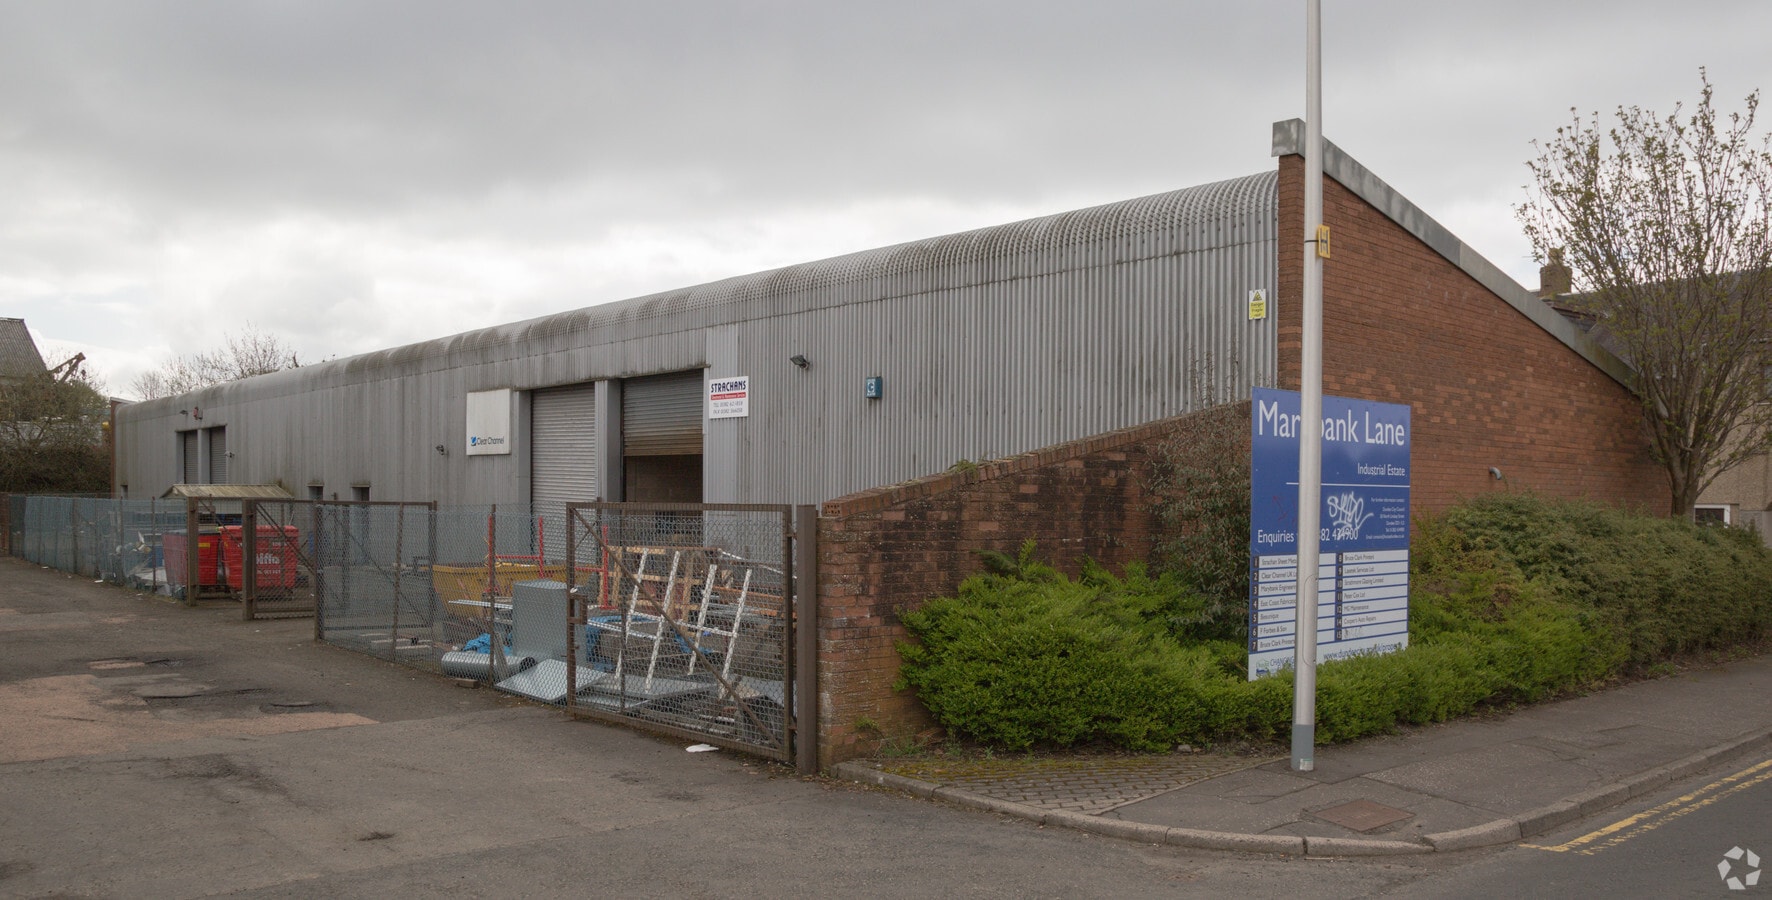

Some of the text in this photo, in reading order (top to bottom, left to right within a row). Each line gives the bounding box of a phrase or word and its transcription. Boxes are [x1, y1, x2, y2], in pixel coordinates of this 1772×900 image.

[711, 381, 746, 392] STRACHANS
[1365, 411, 1405, 446] Lane
[488, 436, 504, 444] Channel
[1358, 463, 1405, 476] Industrial Estate
[1258, 530, 1294, 546] Enquiries
